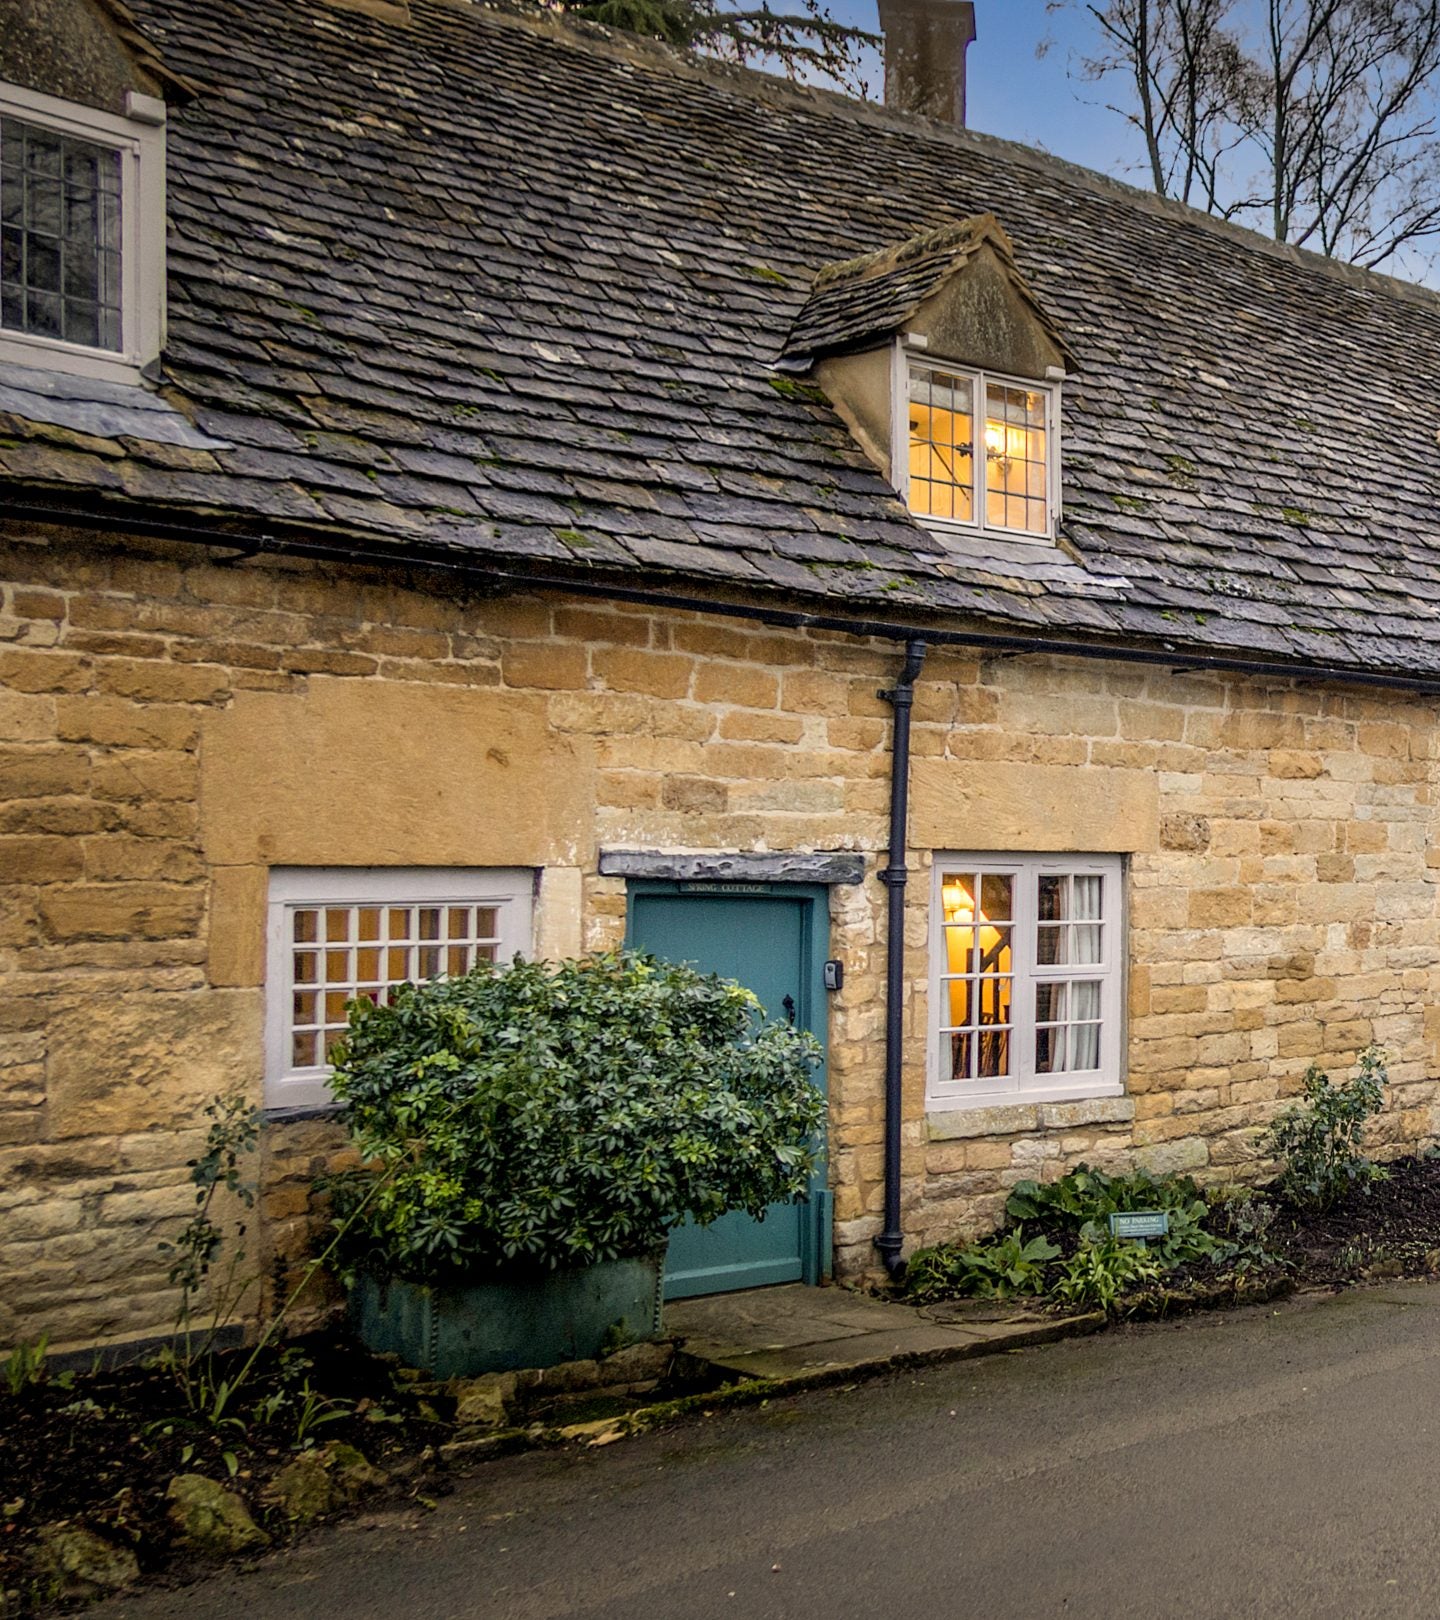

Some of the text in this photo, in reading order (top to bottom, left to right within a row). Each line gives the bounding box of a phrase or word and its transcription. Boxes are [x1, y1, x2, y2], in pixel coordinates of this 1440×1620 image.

[687, 883, 765, 893] SPRING COTTAGE
[1120, 1215, 1159, 1225] NO PARKING
